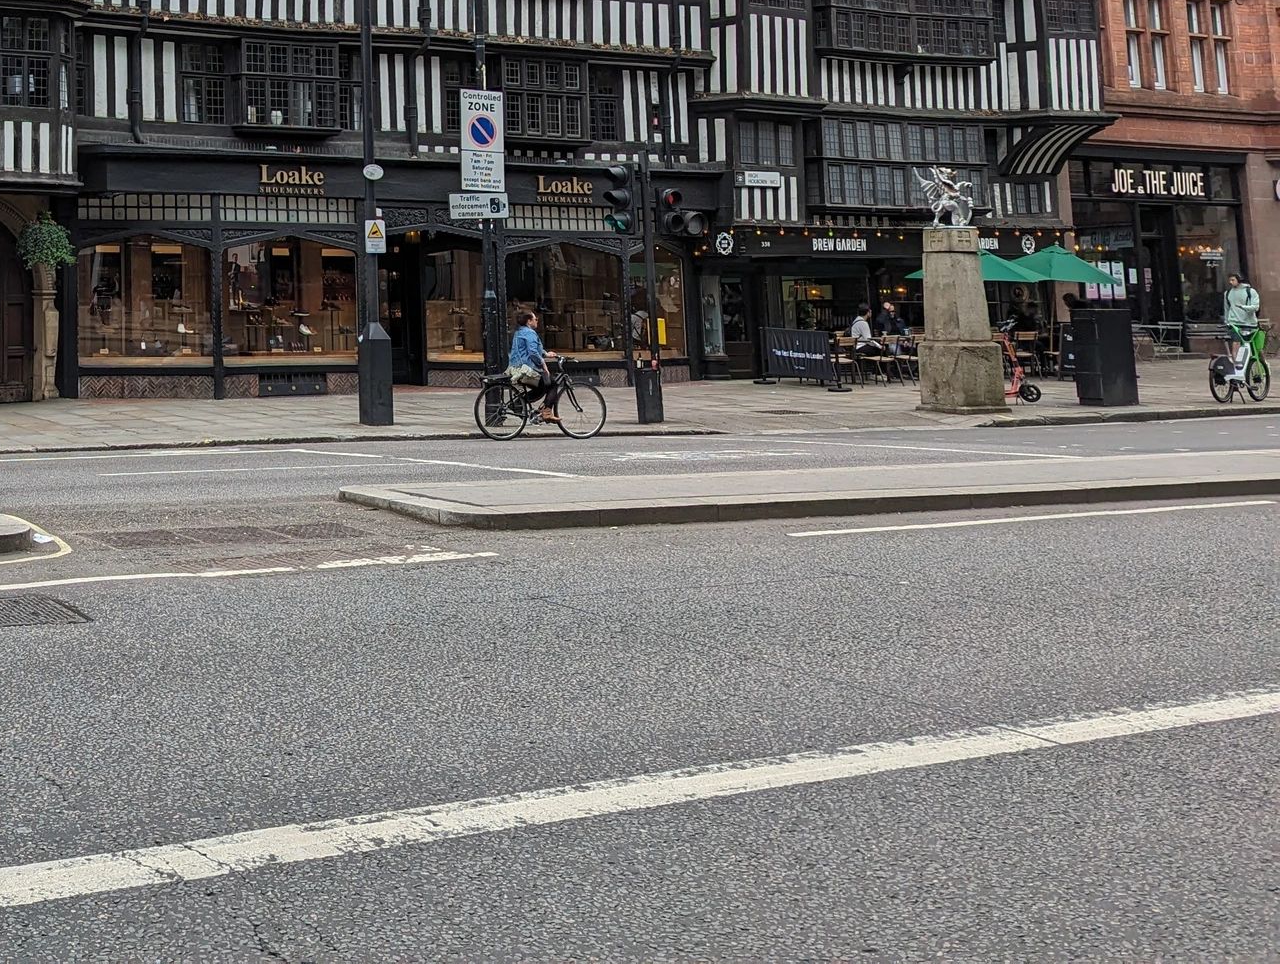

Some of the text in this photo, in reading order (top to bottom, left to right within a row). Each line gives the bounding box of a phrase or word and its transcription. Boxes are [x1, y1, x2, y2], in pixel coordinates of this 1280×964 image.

[462, 92, 501, 101] Controlled
[468, 102, 495, 112] ZONE
[260, 164, 324, 185] Loake
[537, 175, 593, 194] Loake
[1112, 169, 1205, 196] JOE & THE JUICE
[260, 186, 324, 195] SHOEMAKERS
[536, 196, 593, 204] SHOEMAKERS
[812, 238, 867, 252] BREW GARDEN
